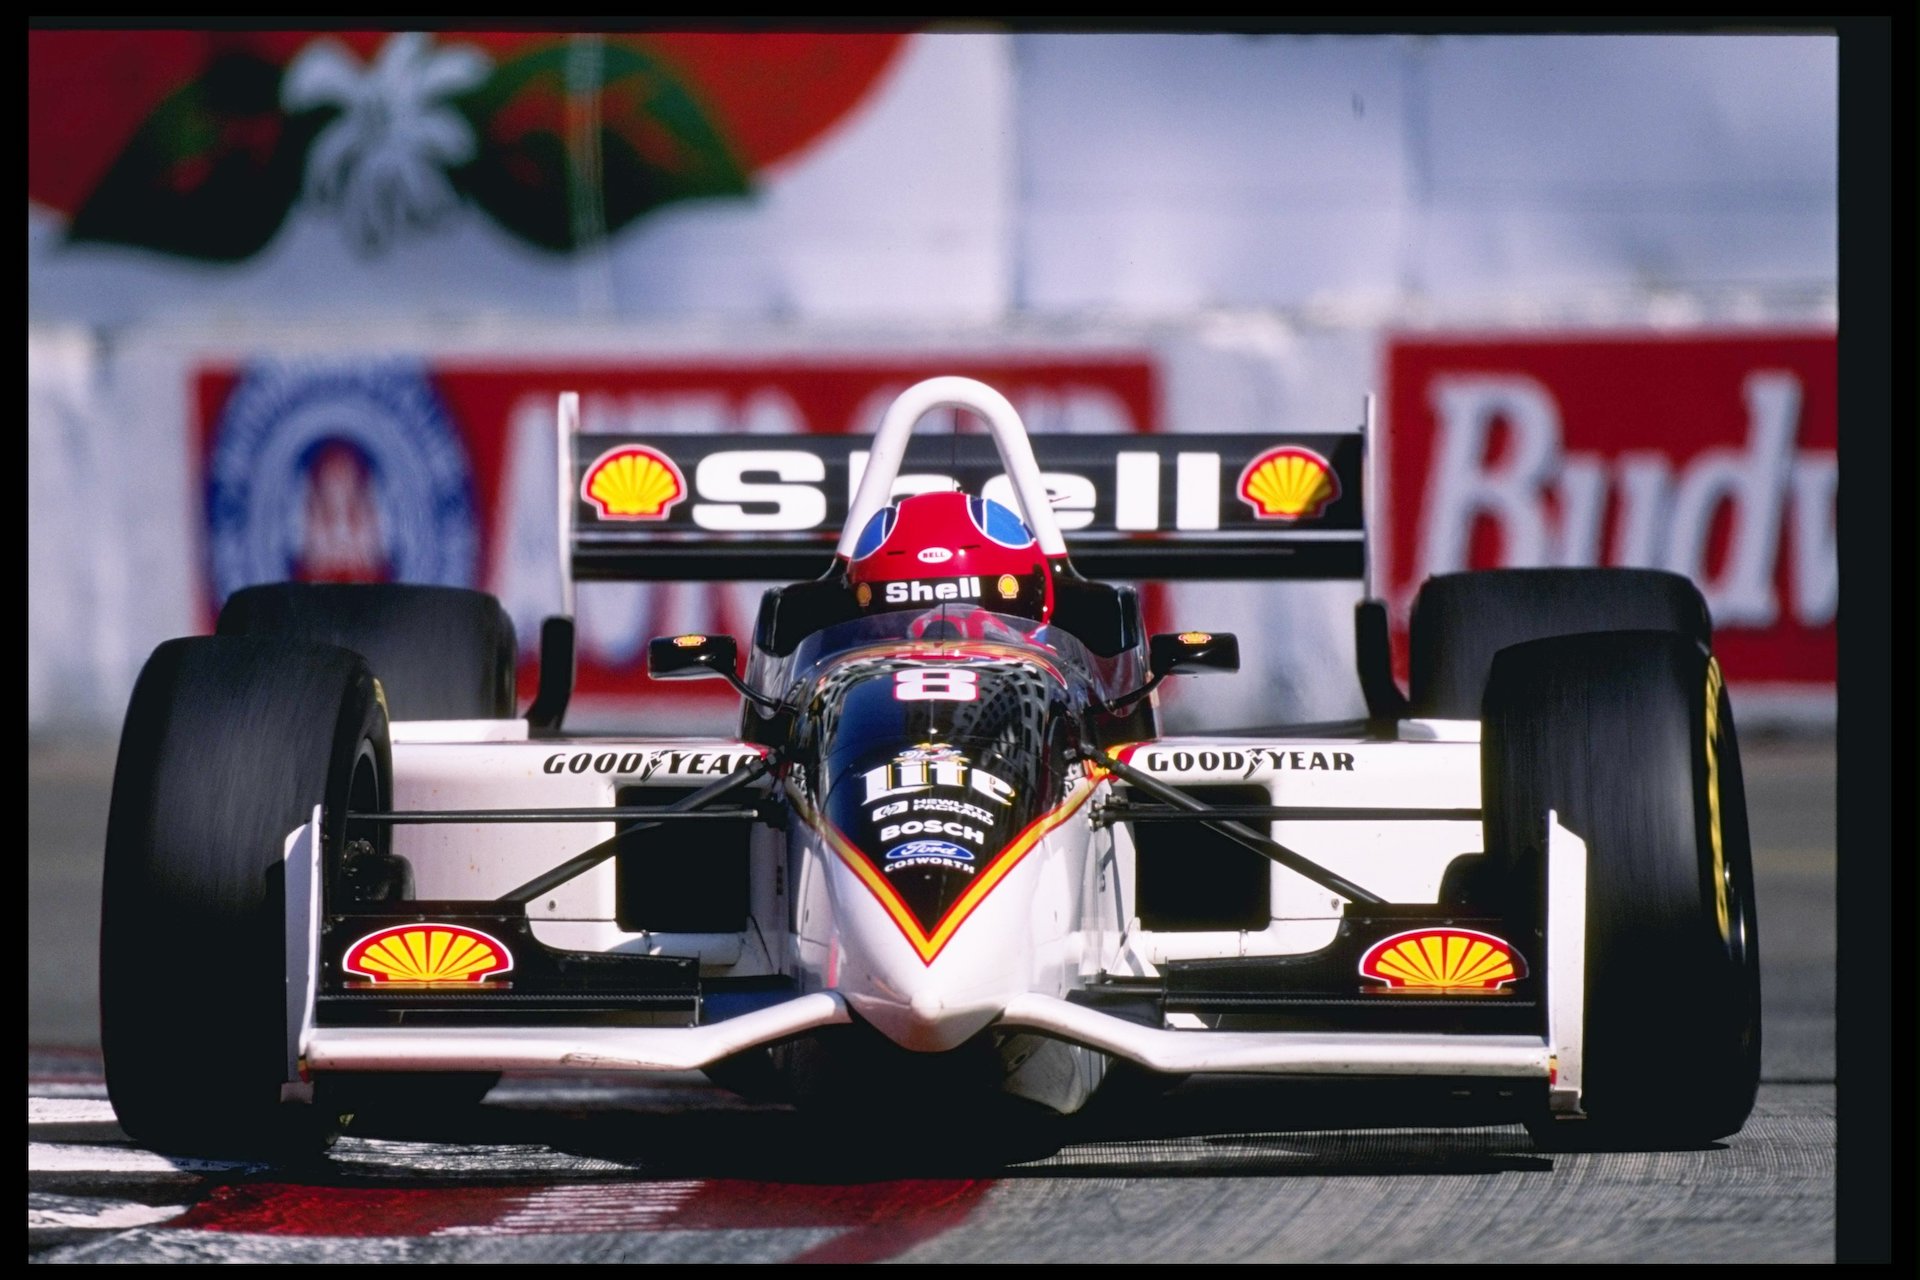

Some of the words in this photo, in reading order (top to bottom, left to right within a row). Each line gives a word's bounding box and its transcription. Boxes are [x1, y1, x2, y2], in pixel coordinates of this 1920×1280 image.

[693, 450, 1220, 531] Sell
[886, 577, 981, 602] Shell
[893, 668, 980, 700] 8
[1147, 751, 1355, 776] GOODYEAR
[861, 760, 1015, 806] Lite
[913, 798, 994, 818] HEWLETT
[913, 804, 994, 826] PACKARD
[880, 820, 984, 845] BOSCH
[900, 842, 957, 855] Ford
[884, 857, 975, 874] COSWORTH
